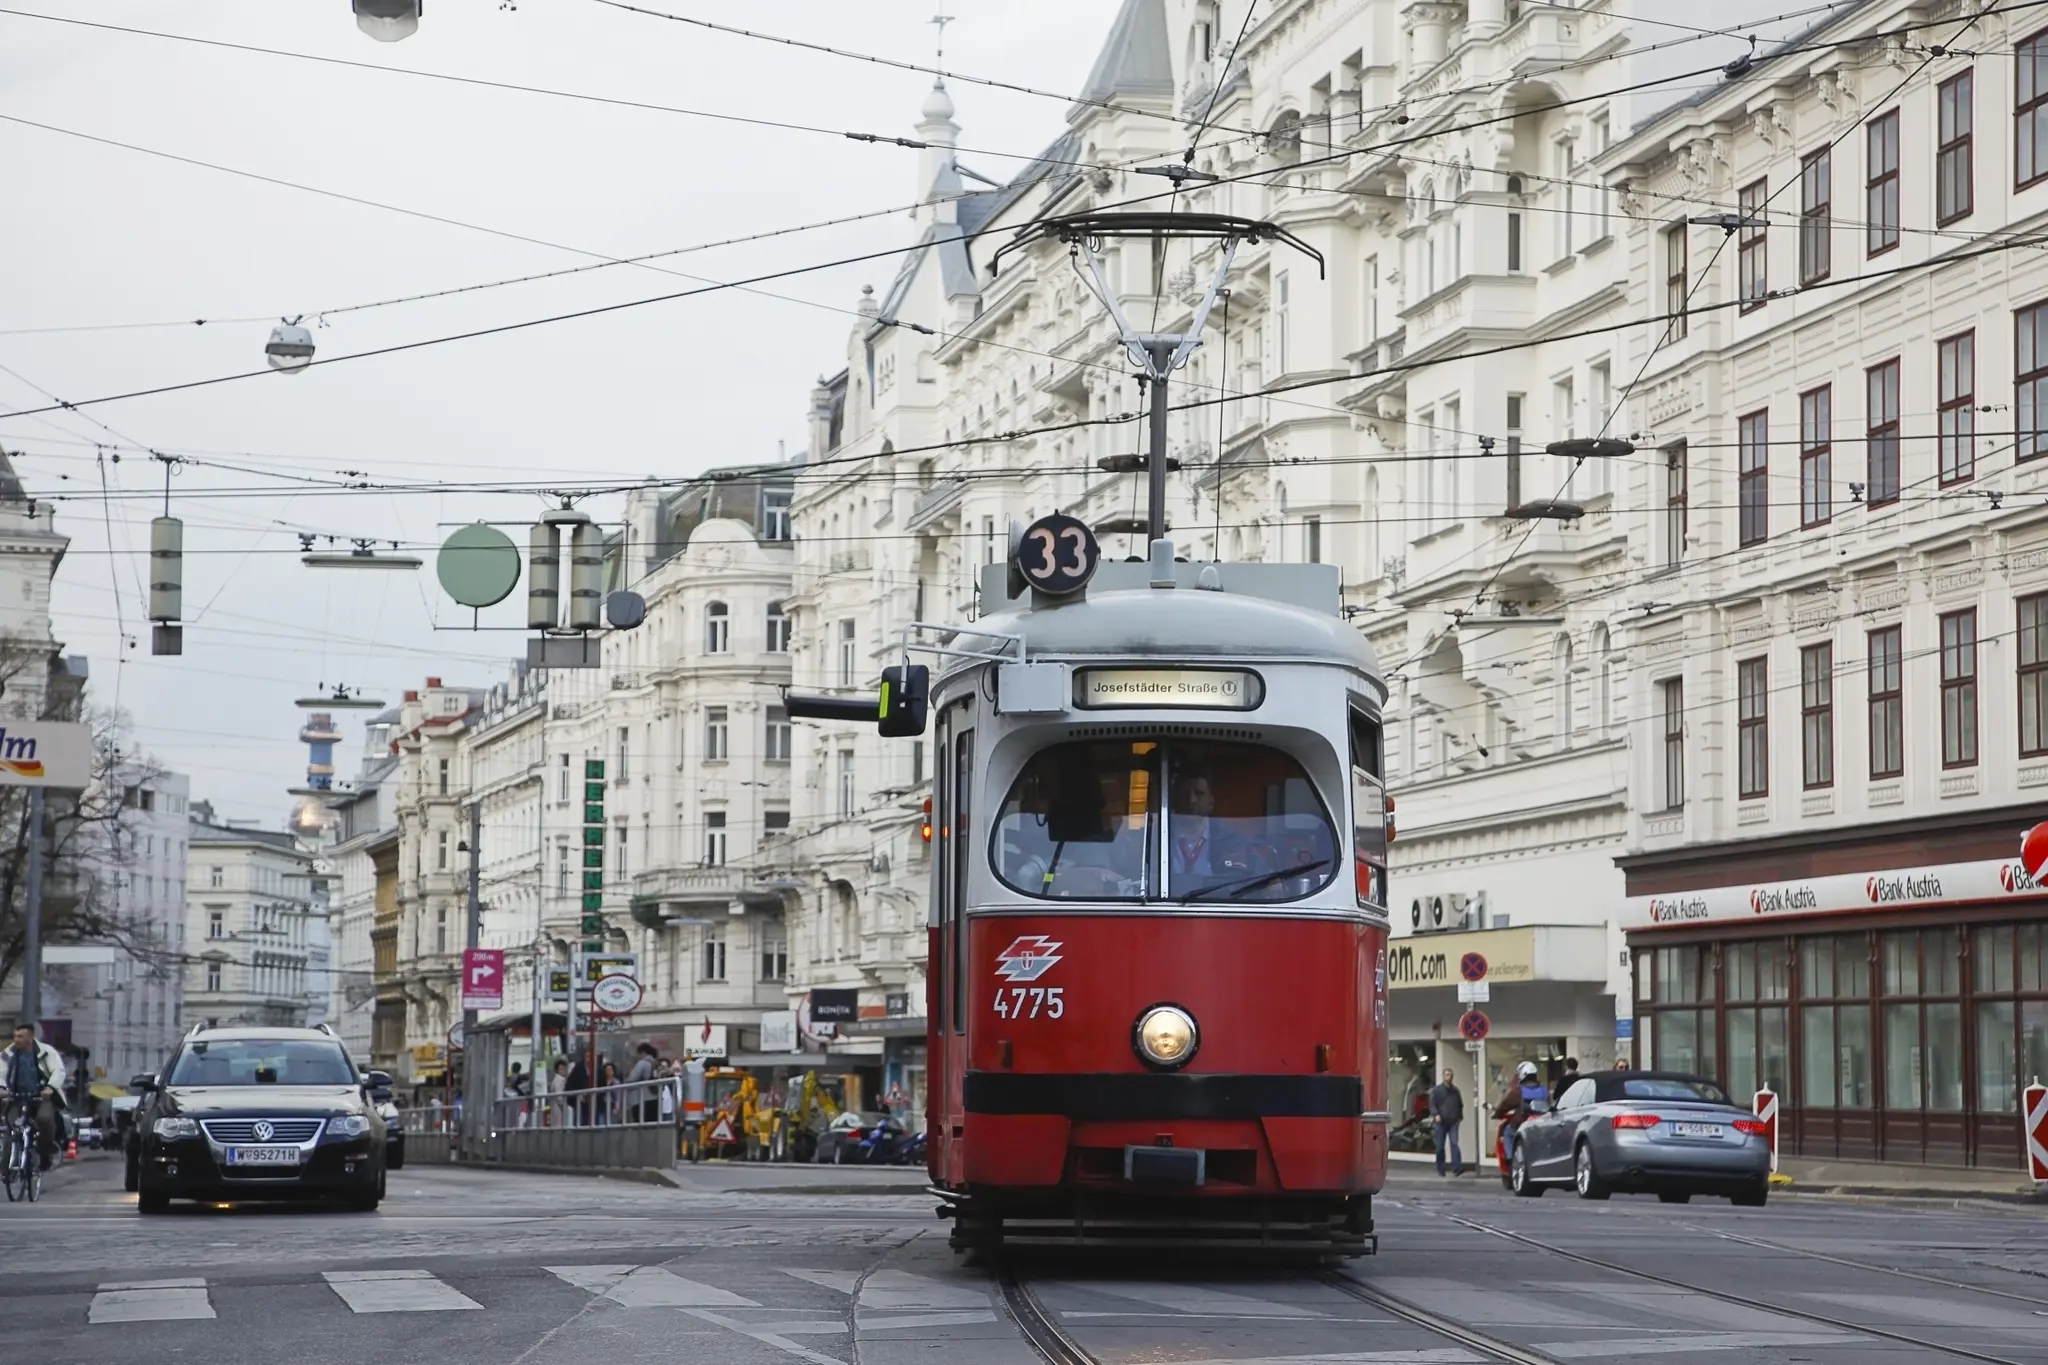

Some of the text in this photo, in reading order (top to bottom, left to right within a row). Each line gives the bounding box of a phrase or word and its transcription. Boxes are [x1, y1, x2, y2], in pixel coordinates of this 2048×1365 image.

[1029, 526, 1087, 579] 33
[1094, 681, 1172, 693] Josefstädter
[1177, 682, 1218, 693] Straße
[1761, 886, 1817, 912] Bank Austria
[1878, 873, 1943, 901] Bank Austria
[1658, 897, 1709, 921] Bank Austria
[993, 988, 1064, 1019] 4775
